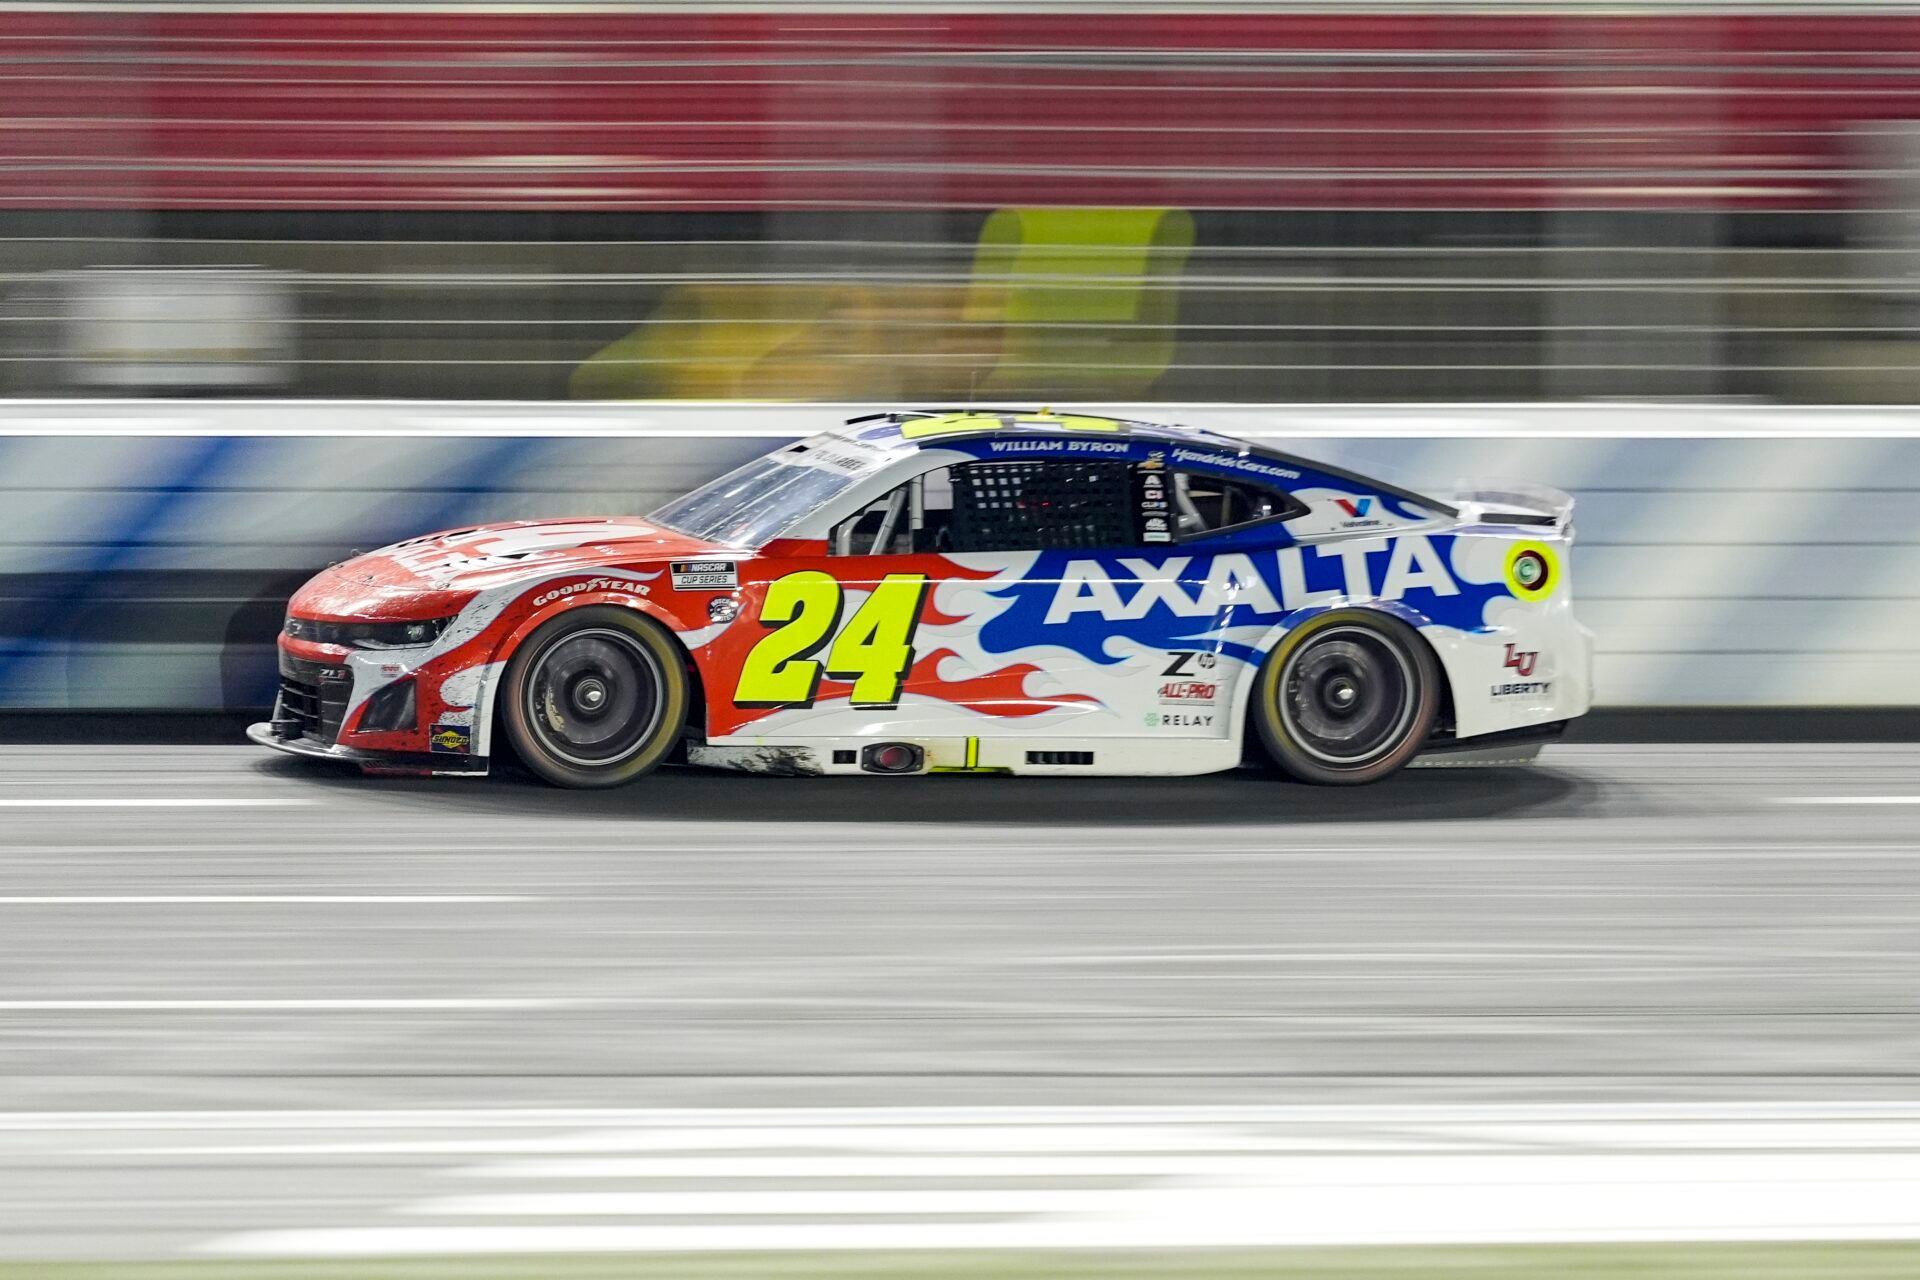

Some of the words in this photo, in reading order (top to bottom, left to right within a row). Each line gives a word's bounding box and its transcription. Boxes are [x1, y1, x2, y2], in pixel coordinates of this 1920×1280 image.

[989, 441, 1063, 452] WILLIAM
[1066, 441, 1129, 453] BYRON
[691, 563, 727, 572] NASCAR
[681, 576, 698, 584] CUP
[699, 575, 728, 584] SERIES
[1043, 535, 1461, 625] AXALTA
[533, 578, 651, 607] GOODYEAR
[733, 571, 928, 710] 24
[1160, 652, 1197, 676] Z
[1158, 683, 1216, 699] ALL-PRO
[1490, 682, 1552, 696] LIBERTY
[1162, 714, 1213, 726] RELAY
